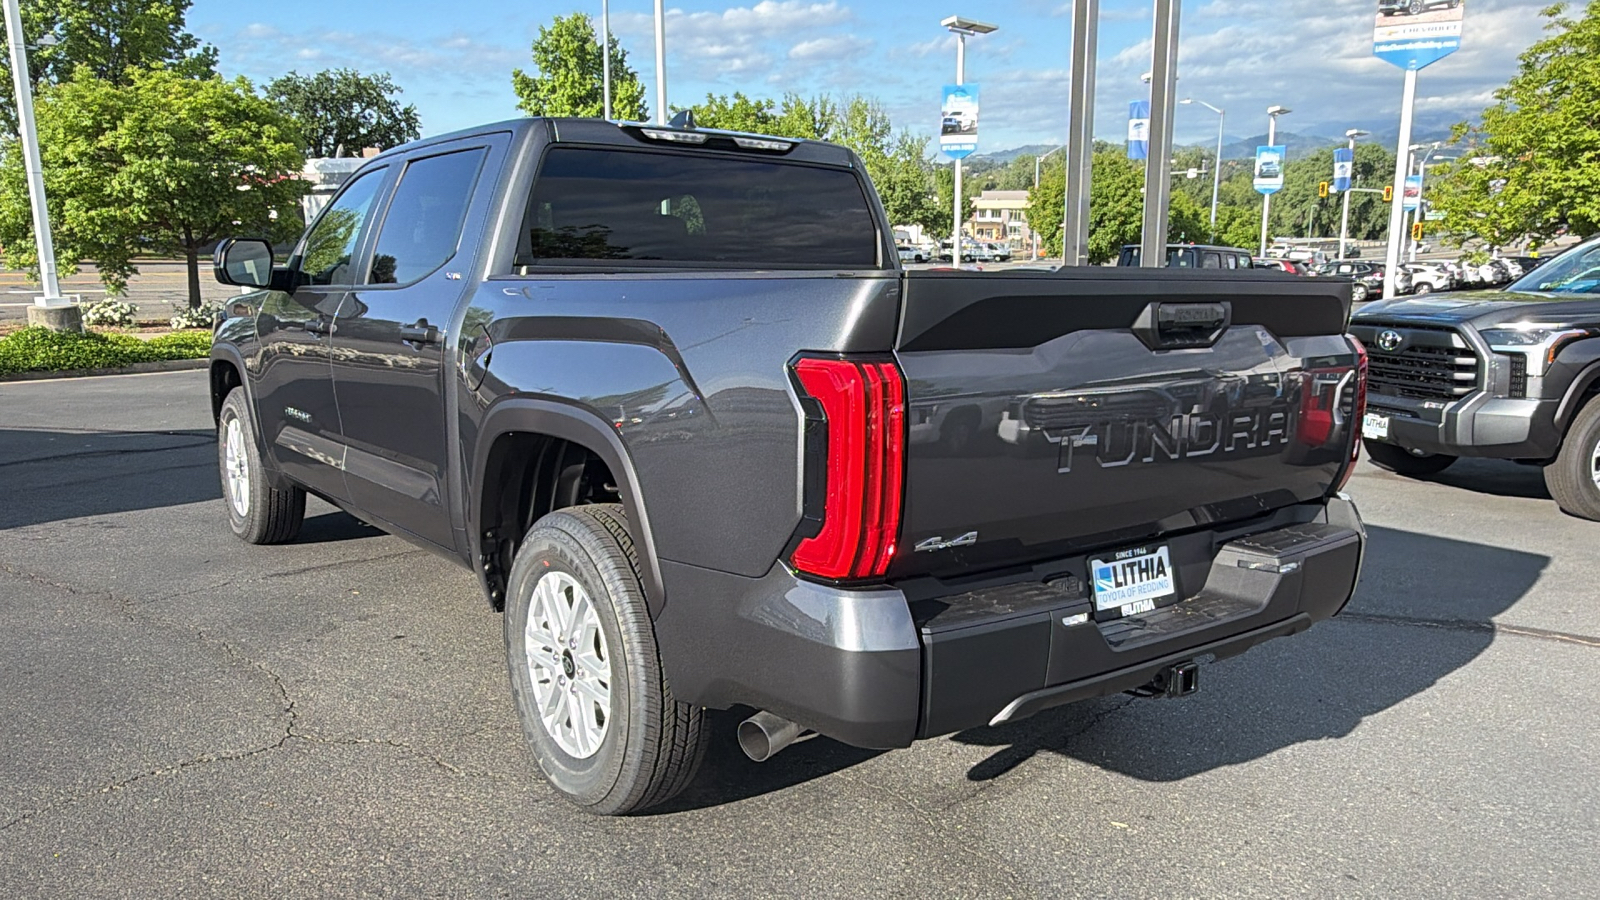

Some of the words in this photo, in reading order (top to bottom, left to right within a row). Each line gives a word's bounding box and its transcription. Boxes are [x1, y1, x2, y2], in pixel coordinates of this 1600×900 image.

[1043, 405, 1288, 473] TUNDRA
[1115, 549, 1133, 560] SINCE
[1112, 555, 1167, 589] LITHIA
[1099, 590, 1126, 603] TOYOTA
[1127, 586, 1136, 598] OF
[1138, 579, 1169, 595] REDDING
